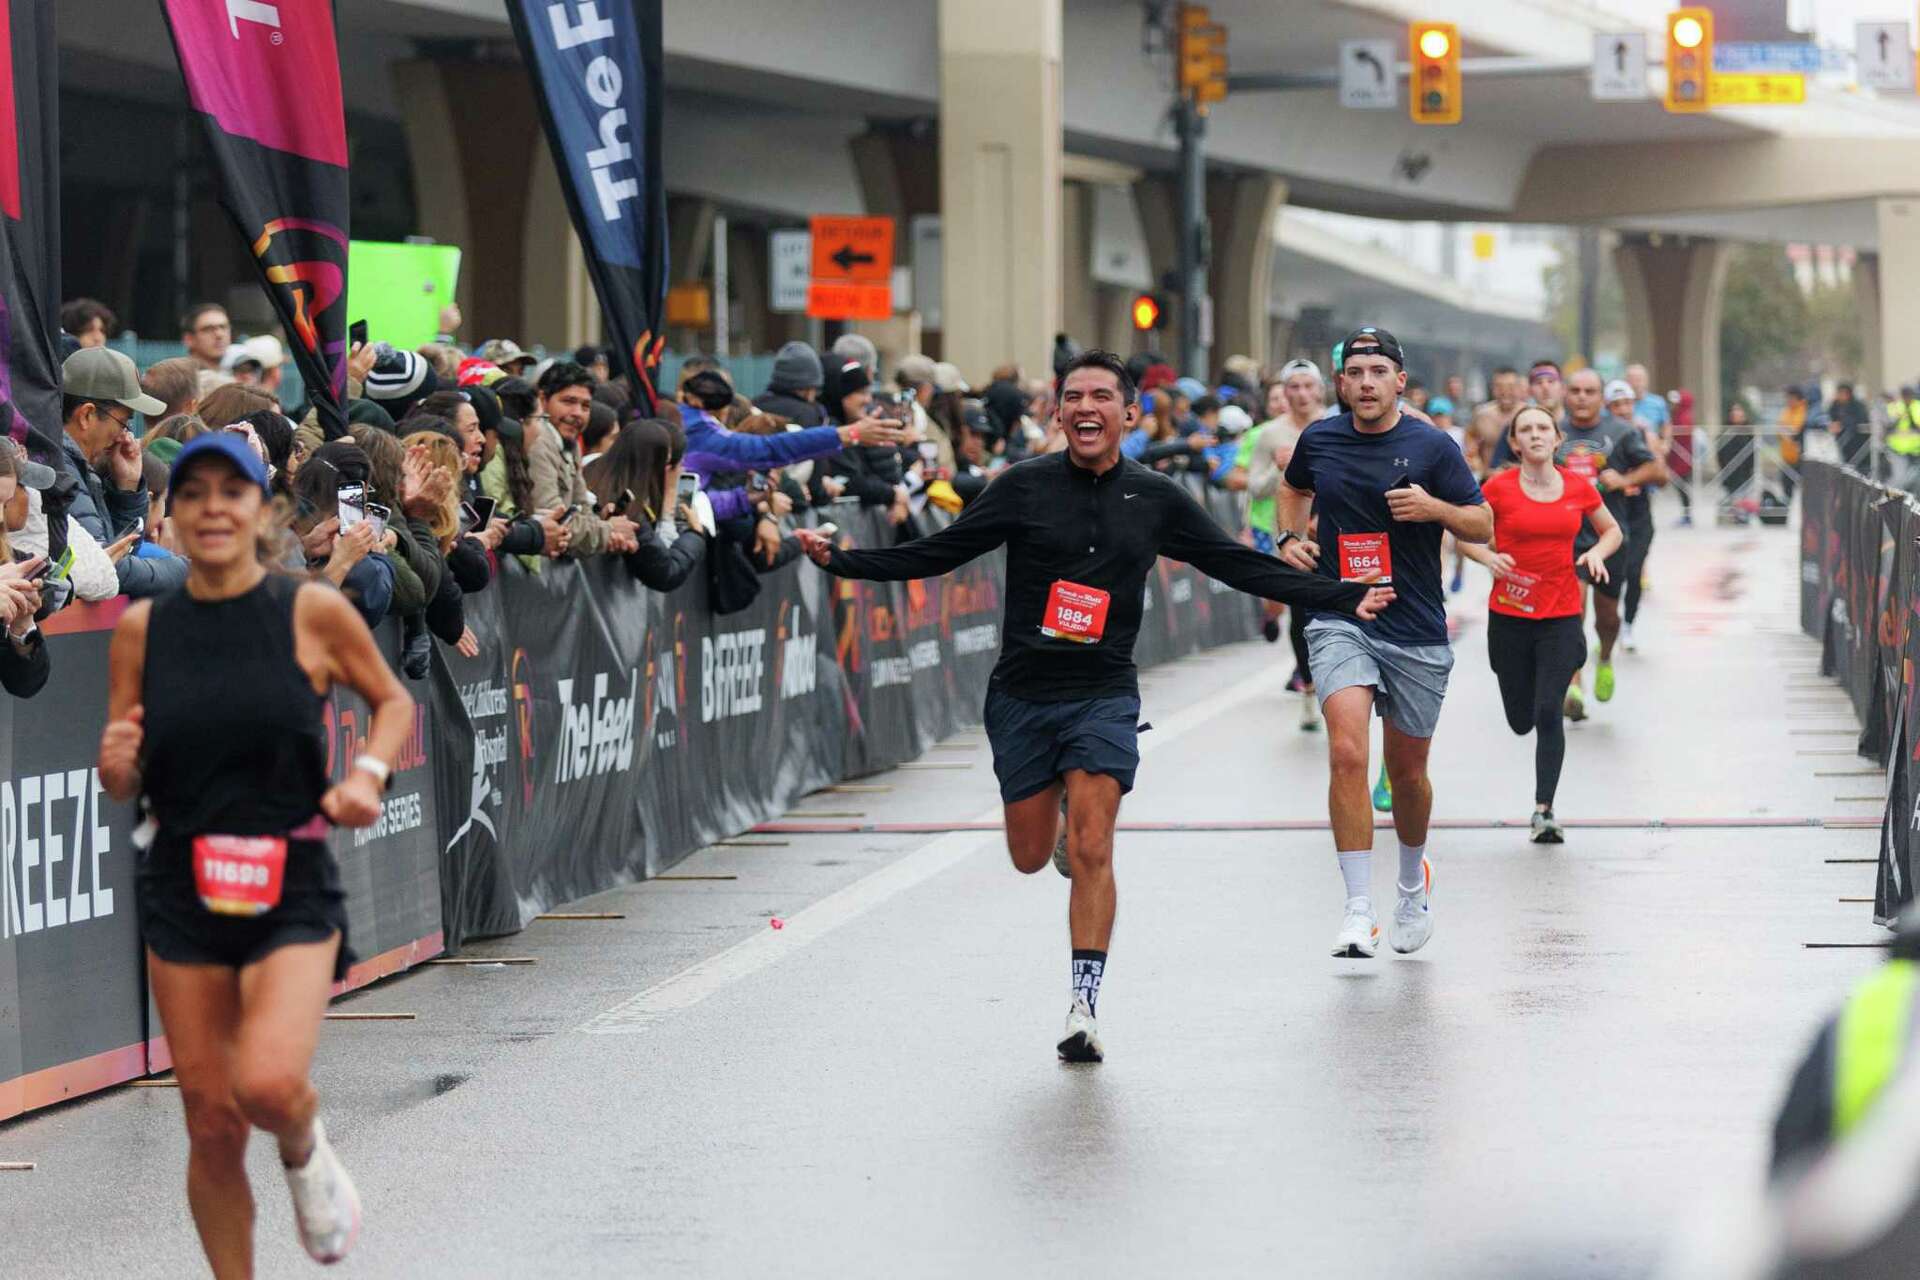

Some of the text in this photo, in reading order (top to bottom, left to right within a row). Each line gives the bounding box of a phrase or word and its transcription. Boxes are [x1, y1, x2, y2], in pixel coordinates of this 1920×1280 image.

[586, 56, 639, 222] The
[1347, 555, 1380, 569] 1664
[1057, 606, 1093, 626] 1884
[554, 678, 590, 784] The
[586, 667, 637, 776] Feed
[388, 792, 422, 835] SERIES
[1073, 959, 1103, 976] IT'S
